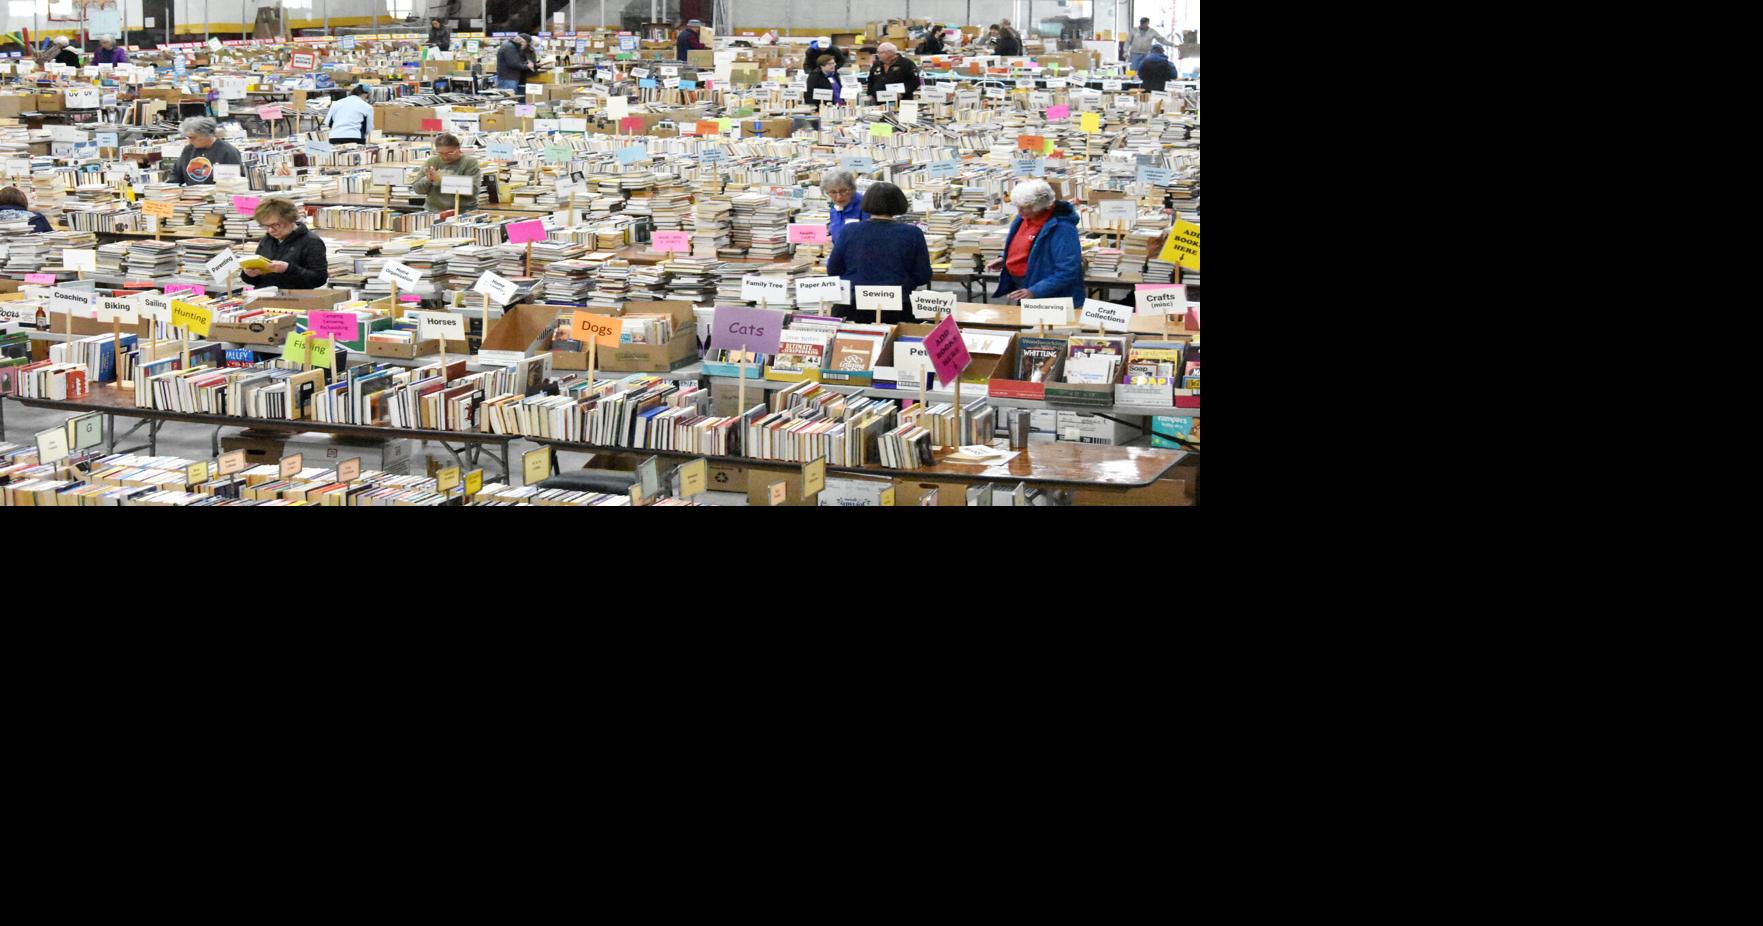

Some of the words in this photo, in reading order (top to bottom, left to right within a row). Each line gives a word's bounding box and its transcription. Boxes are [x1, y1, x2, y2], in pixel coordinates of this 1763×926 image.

[1174, 235, 1200, 247] BOOK
[1174, 244, 1198, 256] HERE
[211, 256, 234, 273] Parenting
[746, 280, 767, 289] Family
[54, 291, 88, 304] Coaching
[862, 290, 895, 299] Sewing
[1146, 293, 1176, 302] Crafts
[104, 301, 131, 311] Biking
[144, 299, 167, 310] Sailing
[915, 296, 949, 306] Jewelry
[1151, 301, 1174, 309] (misc)
[917, 303, 951, 314] Beading
[1023, 303, 1064, 311] Woodcarving
[1098, 307, 1116, 316] Craft
[174, 307, 208, 325] Hunting
[427, 317, 458, 326] Horses
[1085, 311, 1126, 324] Collections
[580, 320, 613, 337] Dogs
[728, 322, 765, 337] Cats
[294, 340, 327, 355] Fising
[1023, 349, 1057, 358] WHITTLING
